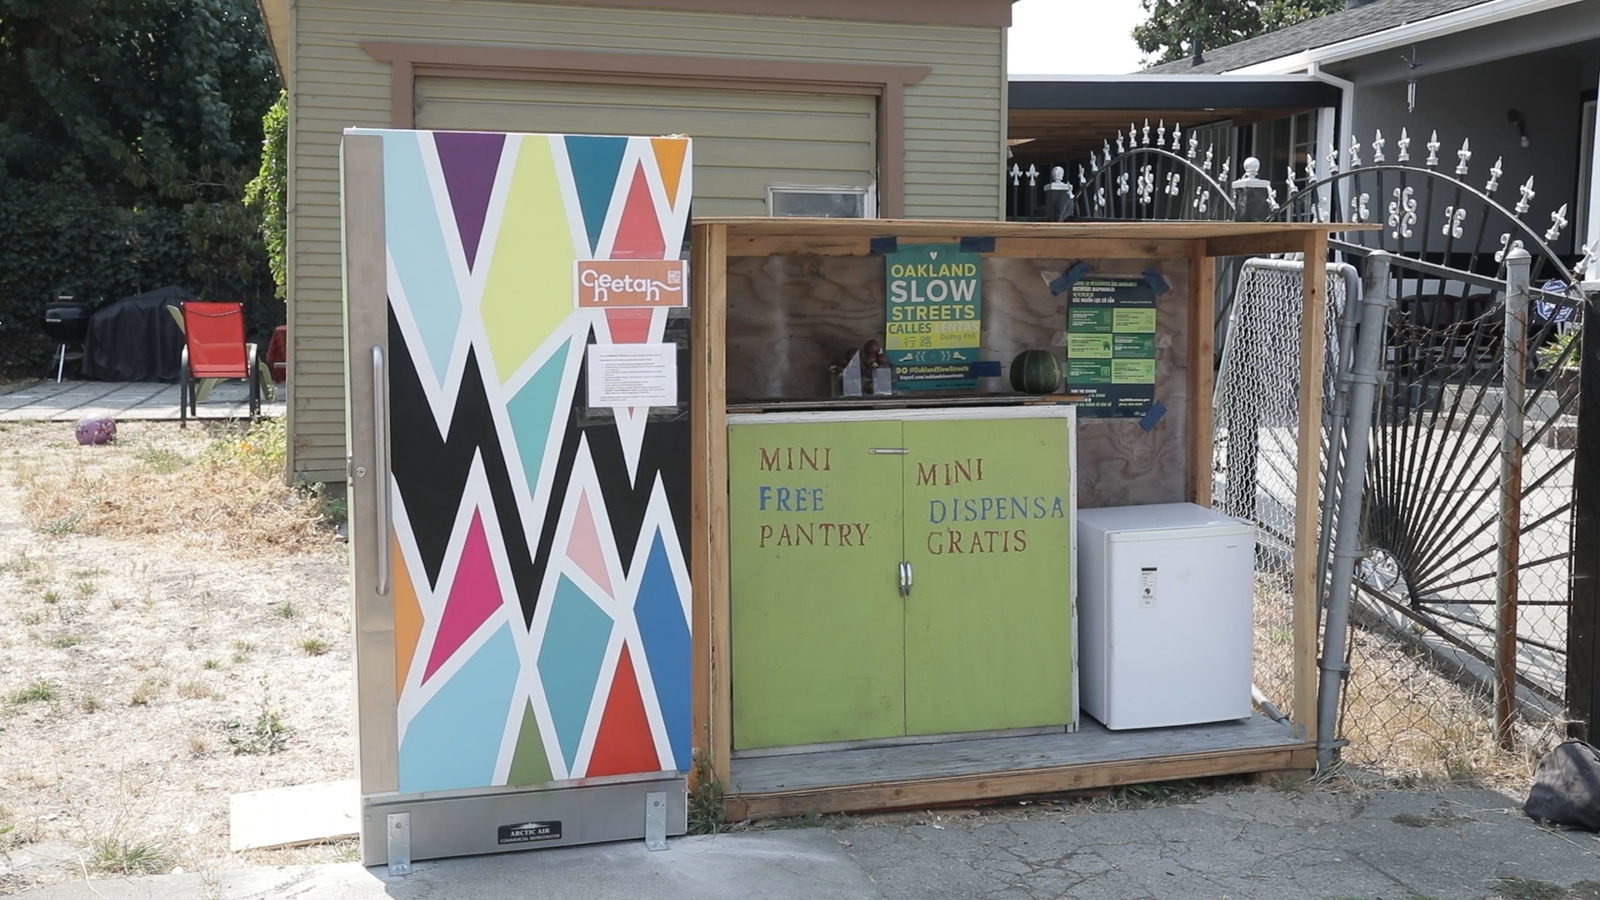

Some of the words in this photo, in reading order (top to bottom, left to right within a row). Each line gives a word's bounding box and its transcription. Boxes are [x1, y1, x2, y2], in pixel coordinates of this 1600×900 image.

[891, 263, 976, 278] OAKLAND
[581, 269, 681, 301] Cheetah
[891, 279, 977, 303] SLOW
[892, 305, 975, 320] STREETS
[888, 323, 932, 334] CALLES
[934, 321, 979, 333] LENTAS
[909, 365, 969, 374] #OaklandSlowStreets
[759, 447, 831, 471] MINI
[916, 458, 984, 486] MINI
[759, 486, 824, 512] FREE
[929, 496, 1065, 524] DISPENSA
[759, 523, 870, 548] PANTRY
[927, 529, 1027, 555] GRATIS
[510, 829, 536, 837] ARCTIC
